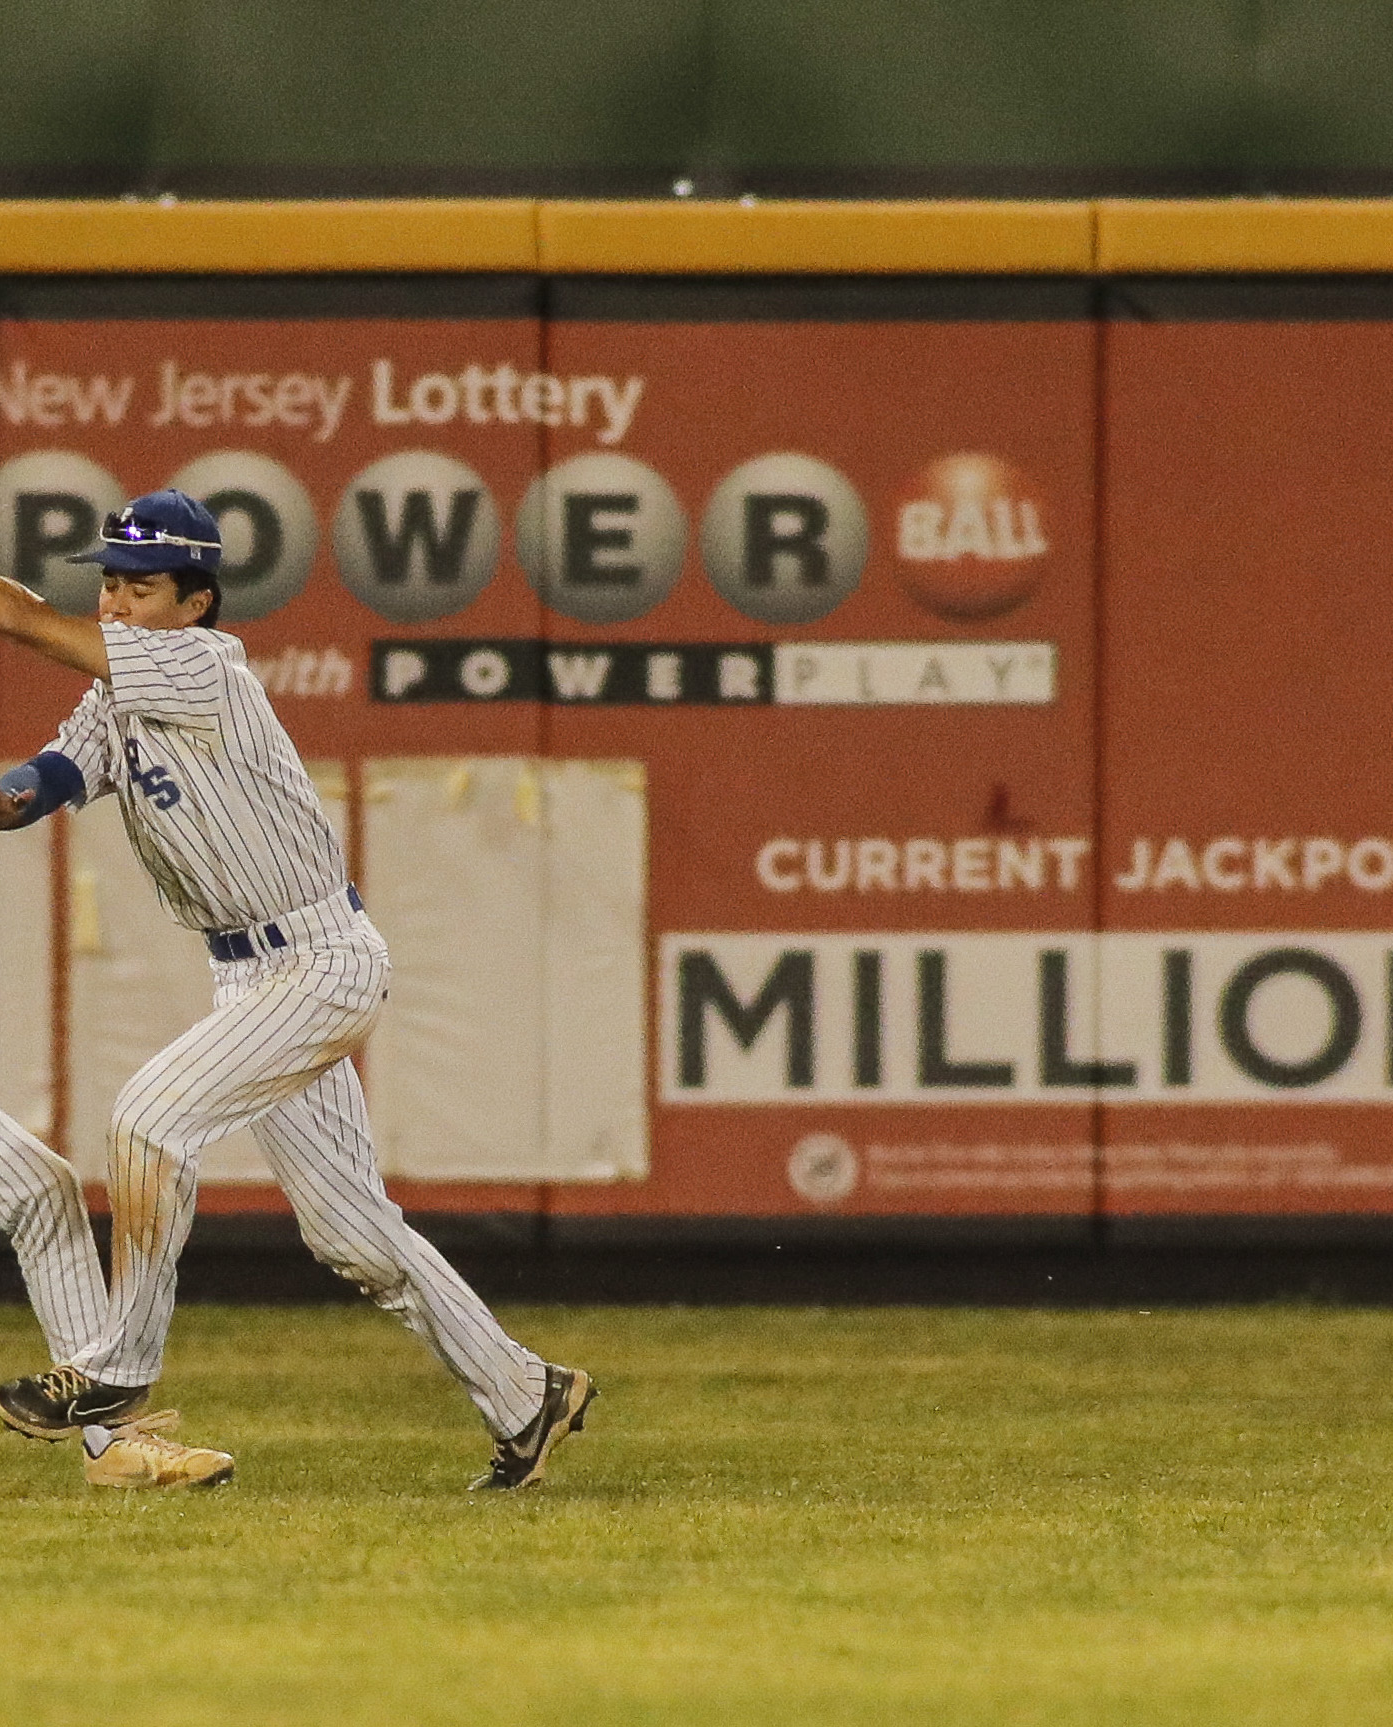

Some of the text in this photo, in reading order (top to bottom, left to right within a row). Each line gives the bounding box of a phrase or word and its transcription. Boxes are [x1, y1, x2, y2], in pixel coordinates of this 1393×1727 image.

[149, 358, 353, 443] Jersey
[371, 357, 645, 444] Lottery
[896, 497, 1050, 562] BALL
[383, 648, 761, 700] POWER
[792, 654, 1014, 698] PLAY
[755, 836, 1393, 894] CURRENT JACKPO
[676, 946, 1393, 1090] MILLIO
